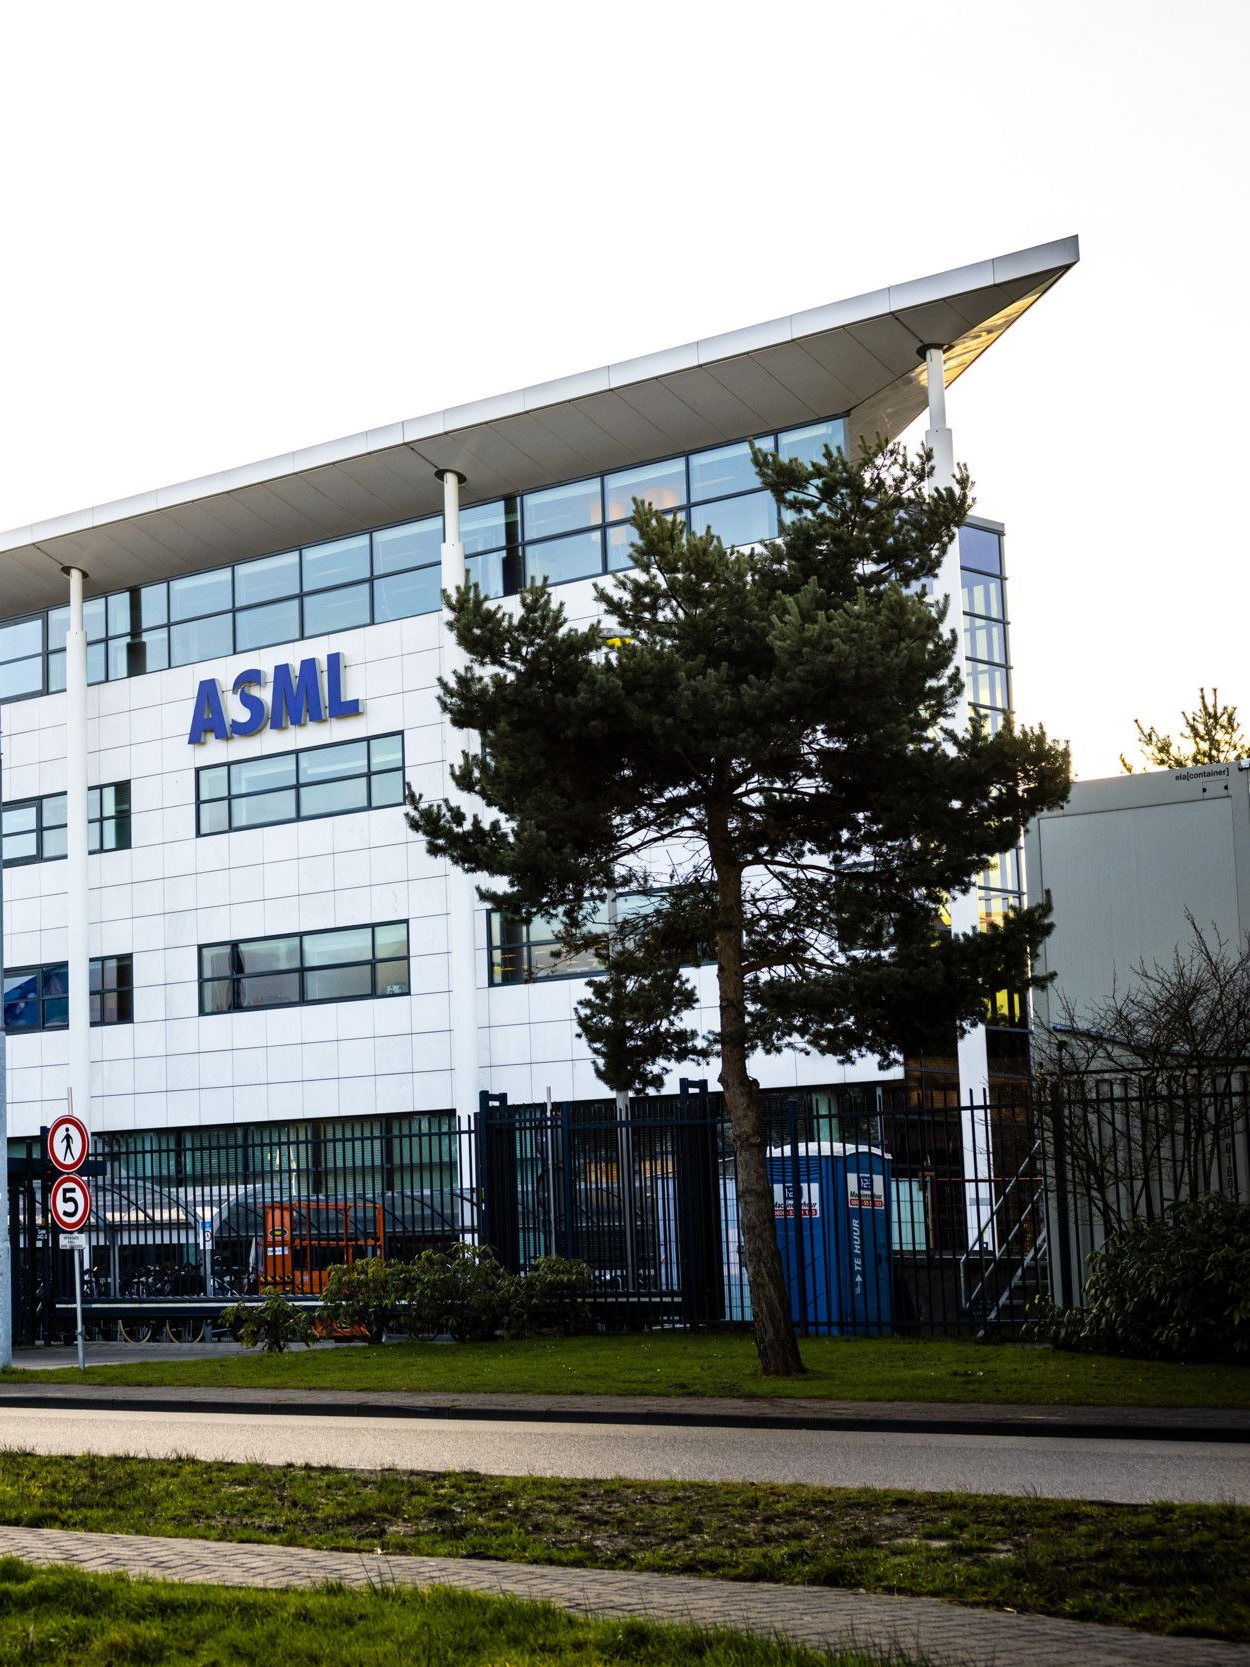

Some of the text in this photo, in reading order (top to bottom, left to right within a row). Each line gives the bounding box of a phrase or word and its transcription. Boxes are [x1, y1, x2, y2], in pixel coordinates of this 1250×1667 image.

[188, 651, 364, 745] ASML
[1175, 767, 1229, 781] ela[container]
[62, 1187, 79, 1218] 5
[852, 1219, 863, 1271] TE HUUR
